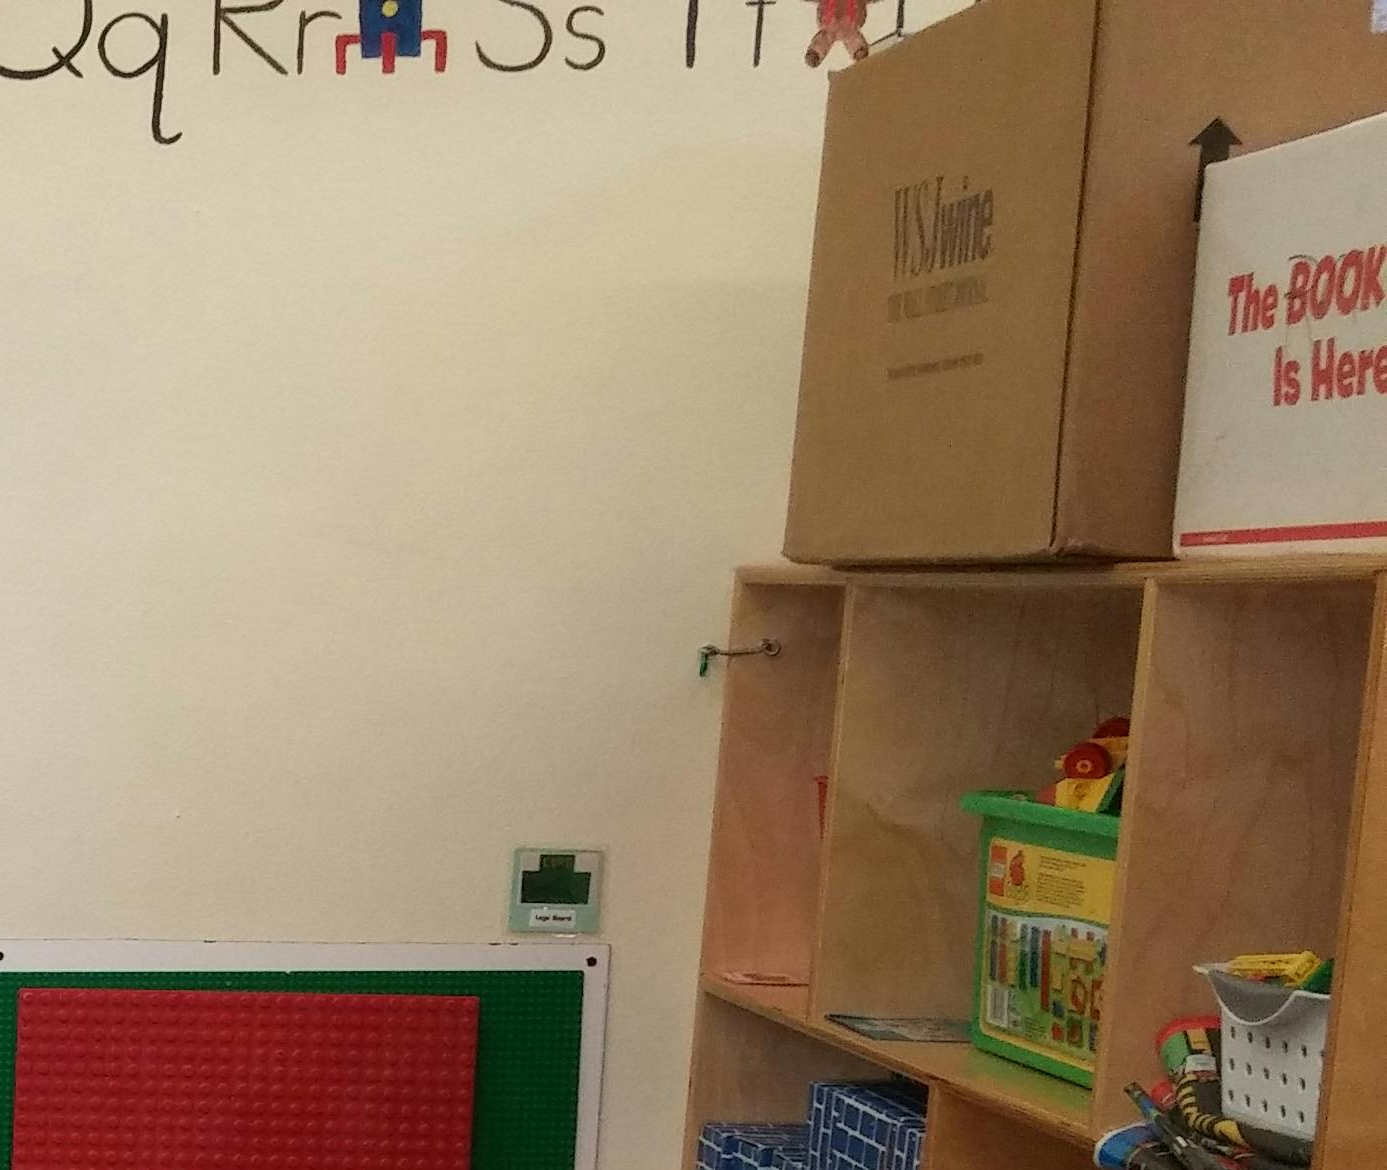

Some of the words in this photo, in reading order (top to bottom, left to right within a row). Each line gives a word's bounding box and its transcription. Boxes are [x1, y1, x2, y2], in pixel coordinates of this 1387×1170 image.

[1227, 272, 1278, 336] The
[1285, 246, 1387, 326] BOOK
[1273, 345, 1301, 407] Is
[1310, 337, 1387, 401] Here
